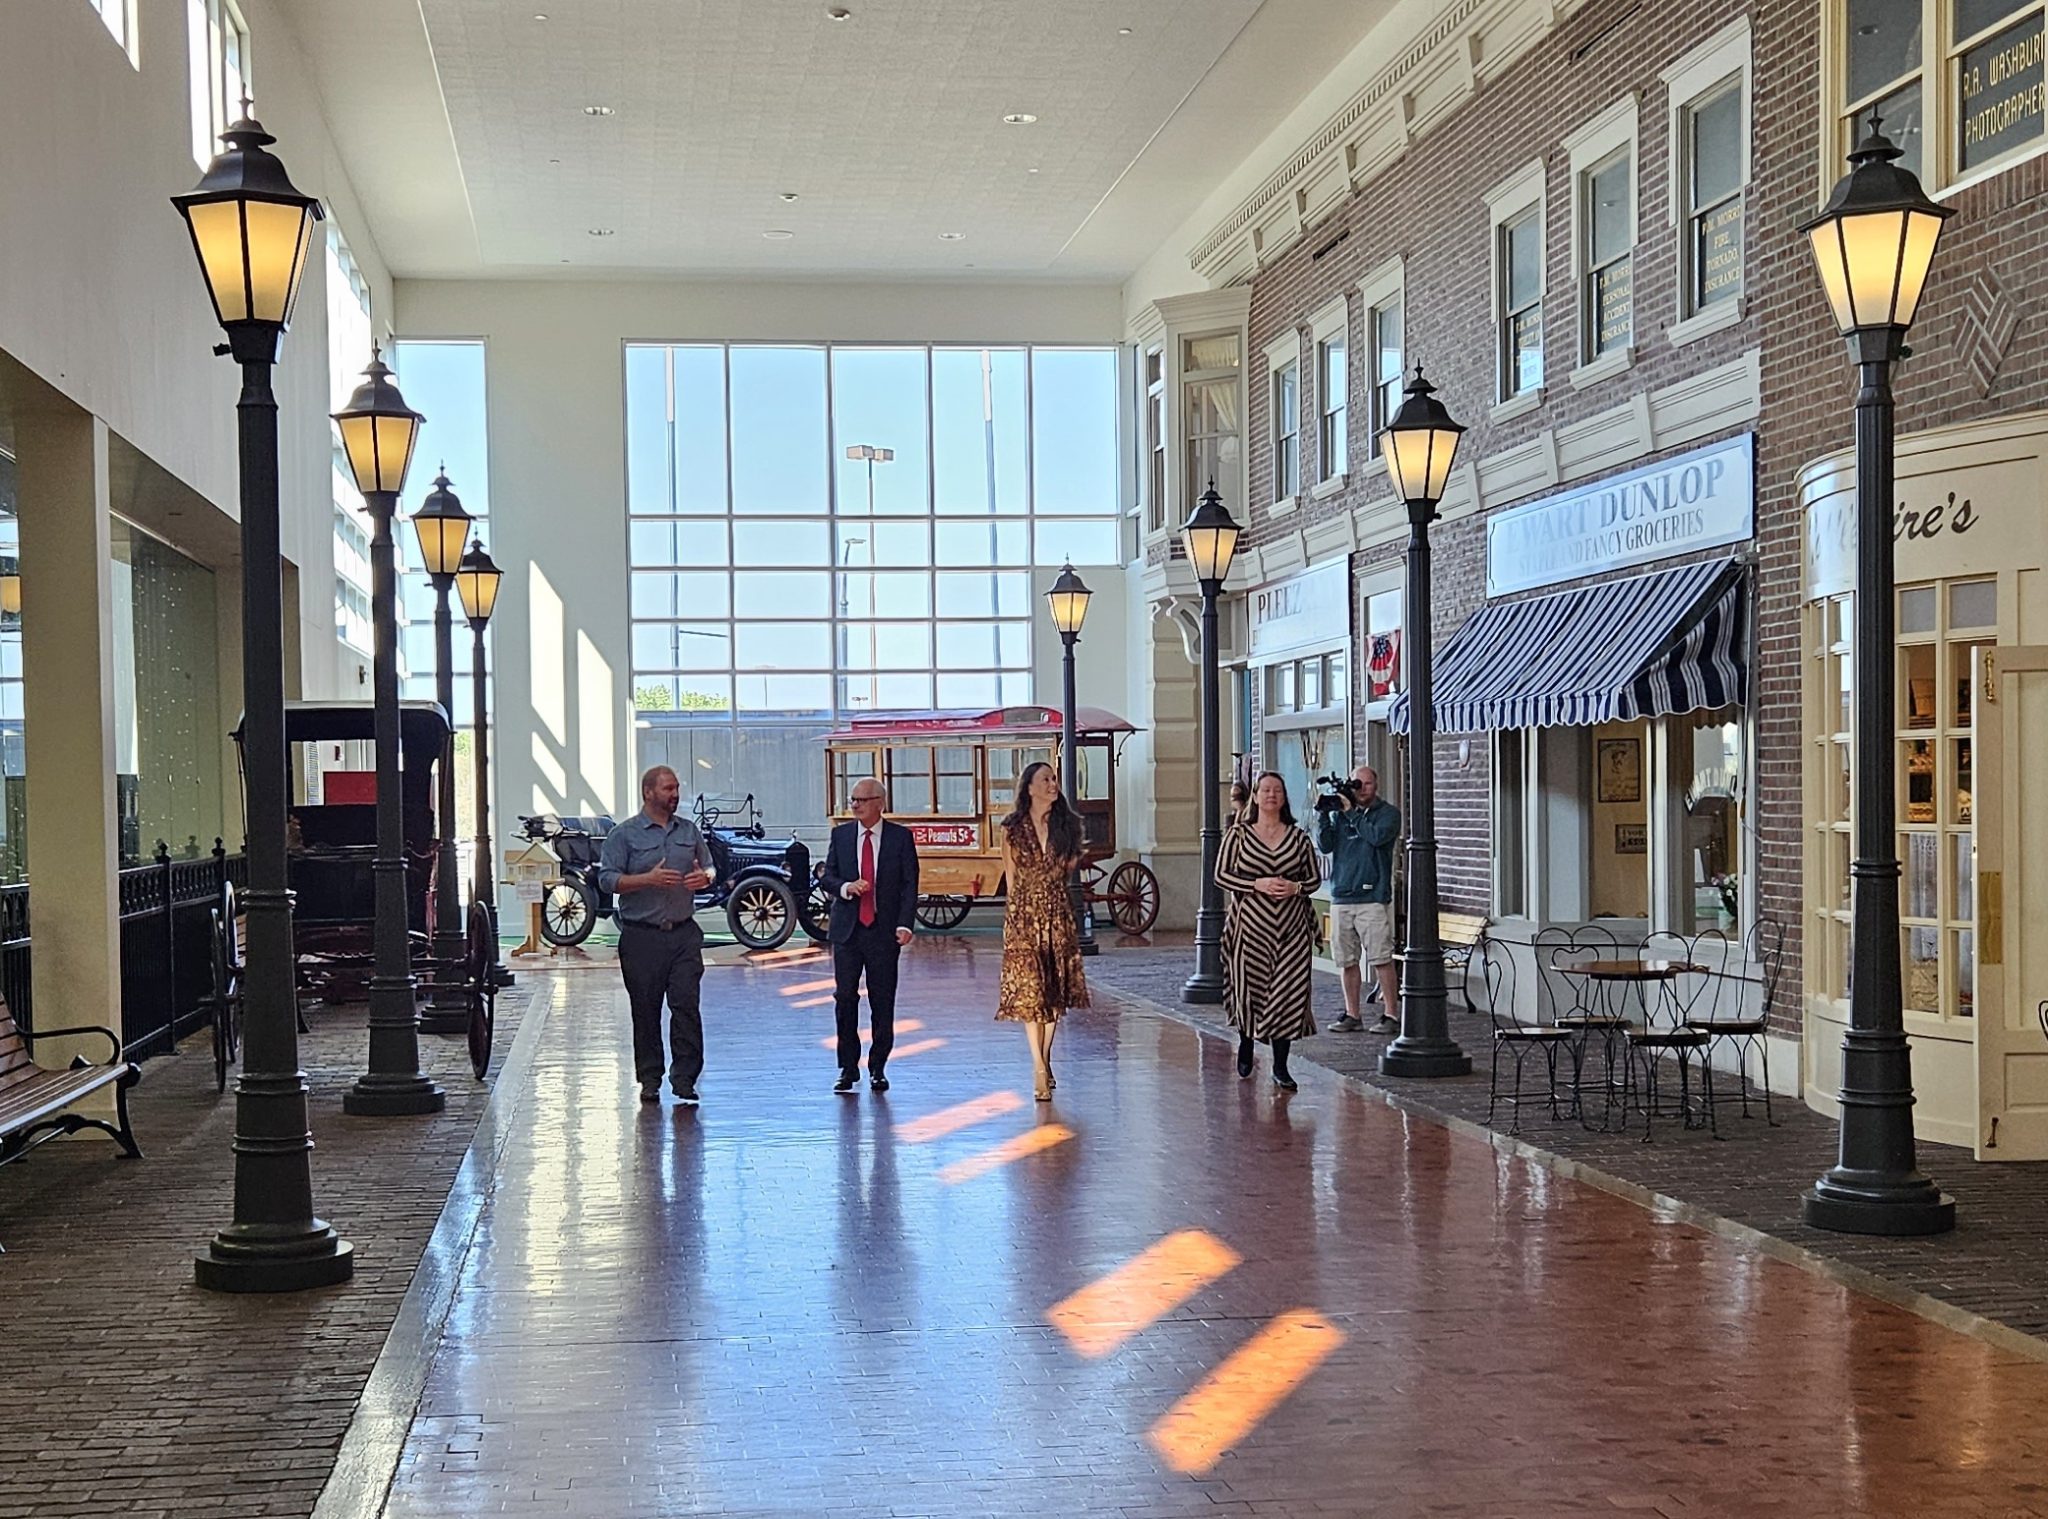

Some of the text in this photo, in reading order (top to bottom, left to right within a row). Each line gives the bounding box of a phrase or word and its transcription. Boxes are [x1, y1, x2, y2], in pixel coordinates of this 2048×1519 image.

[1965, 81, 2045, 146] PHOTOGRAPHER
[1600, 458, 1725, 528] DUNLOP
[1585, 528, 1624, 560] FANCY
[1626, 508, 1704, 551] GROCERIES
